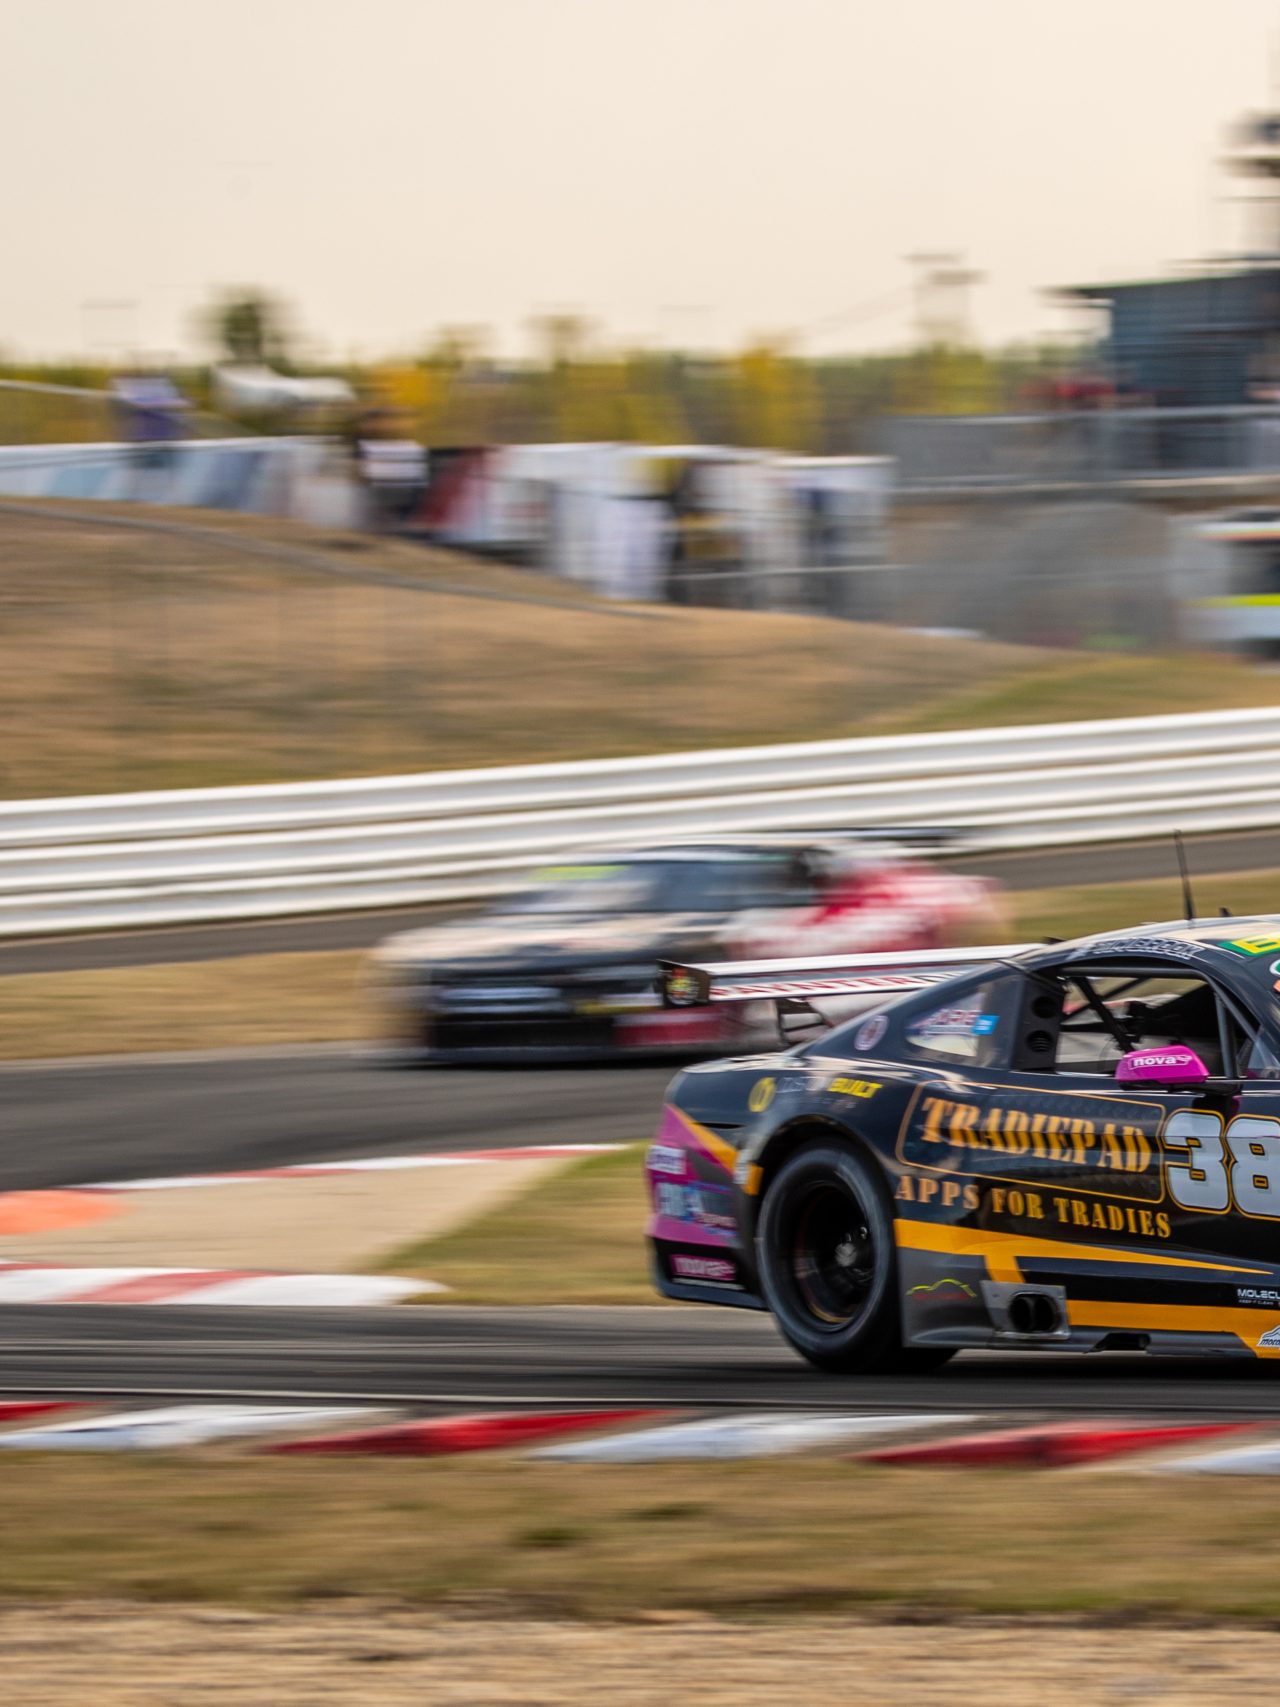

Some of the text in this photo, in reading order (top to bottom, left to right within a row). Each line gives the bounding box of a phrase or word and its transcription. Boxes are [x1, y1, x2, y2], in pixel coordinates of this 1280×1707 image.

[1133, 1056, 1176, 1067] nova
[921, 1097, 1152, 1173] TRADIEPAD
[894, 1175, 1172, 1239] APPS FOR TRADIES
